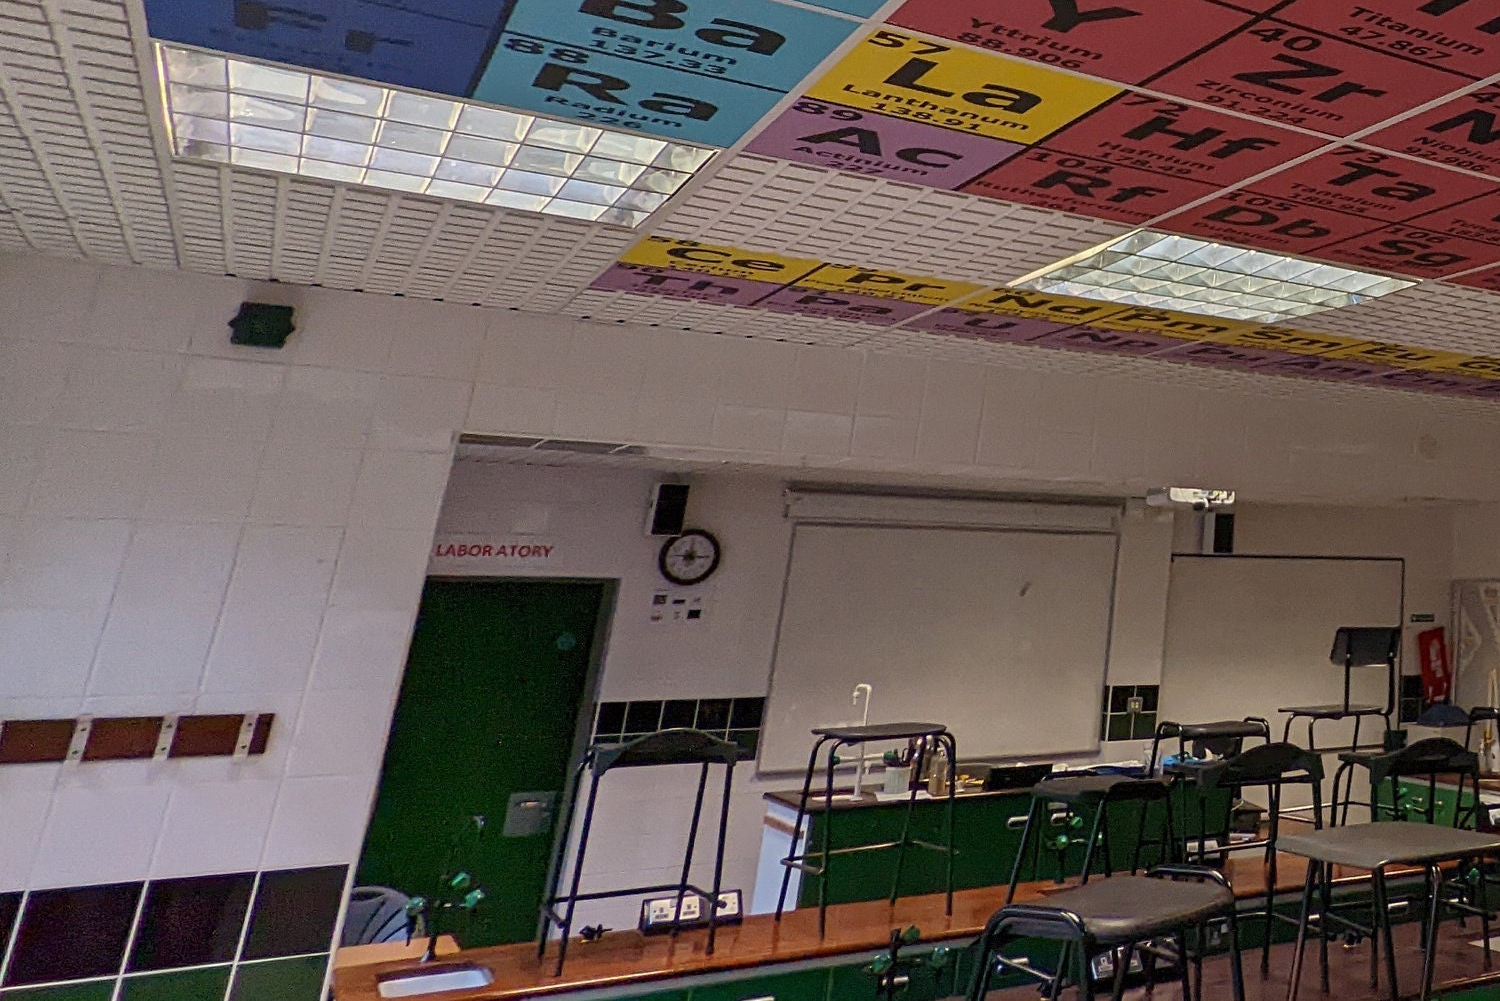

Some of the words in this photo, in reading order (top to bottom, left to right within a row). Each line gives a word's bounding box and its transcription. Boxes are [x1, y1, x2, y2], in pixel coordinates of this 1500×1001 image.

[591, 26, 737, 66] Barium
[868, 30, 954, 56] 57
[970, 17, 1104, 61] Yttrium
[1248, 27, 1323, 54] 40
[1339, 25, 1453, 62] 47.867
[1349, 6, 1485, 56] Titanium
[503, 37, 590, 65] 88
[956, 31, 1083, 69] 88.906
[531, 62, 719, 122] Ra
[882, 57, 1043, 115] La
[1232, 53, 1388, 102] Zr
[544, 95, 683, 128] Radium
[790, 100, 865, 122] 89
[842, 84, 1030, 131] Lanthanum
[1195, 79, 1344, 123] Zirconium
[870, 103, 982, 131] 138.91
[796, 126, 964, 170] Ac
[1122, 116, 1280, 161] Hf
[791, 146, 929, 176] Actinium
[1025, 152, 1115, 175] 104
[1098, 141, 1215, 173] Hafnium
[1032, 170, 1169, 204] Rf
[1290, 182, 1397, 212] Tantalum
[1327, 160, 1436, 203] Ta
[1201, 205, 1332, 239] Db
[666, 247, 786, 272] Ce
[1351, 239, 1470, 268] Sg
[633, 272, 739, 295] Th
[845, 272, 947, 293] Pr
[795, 295, 892, 316] Pa
[988, 294, 1100, 316] Nd
[1117, 312, 1230, 334] Pm
[1240, 327, 1342, 349] Sm
[435, 543, 554, 559] LABORATORY
